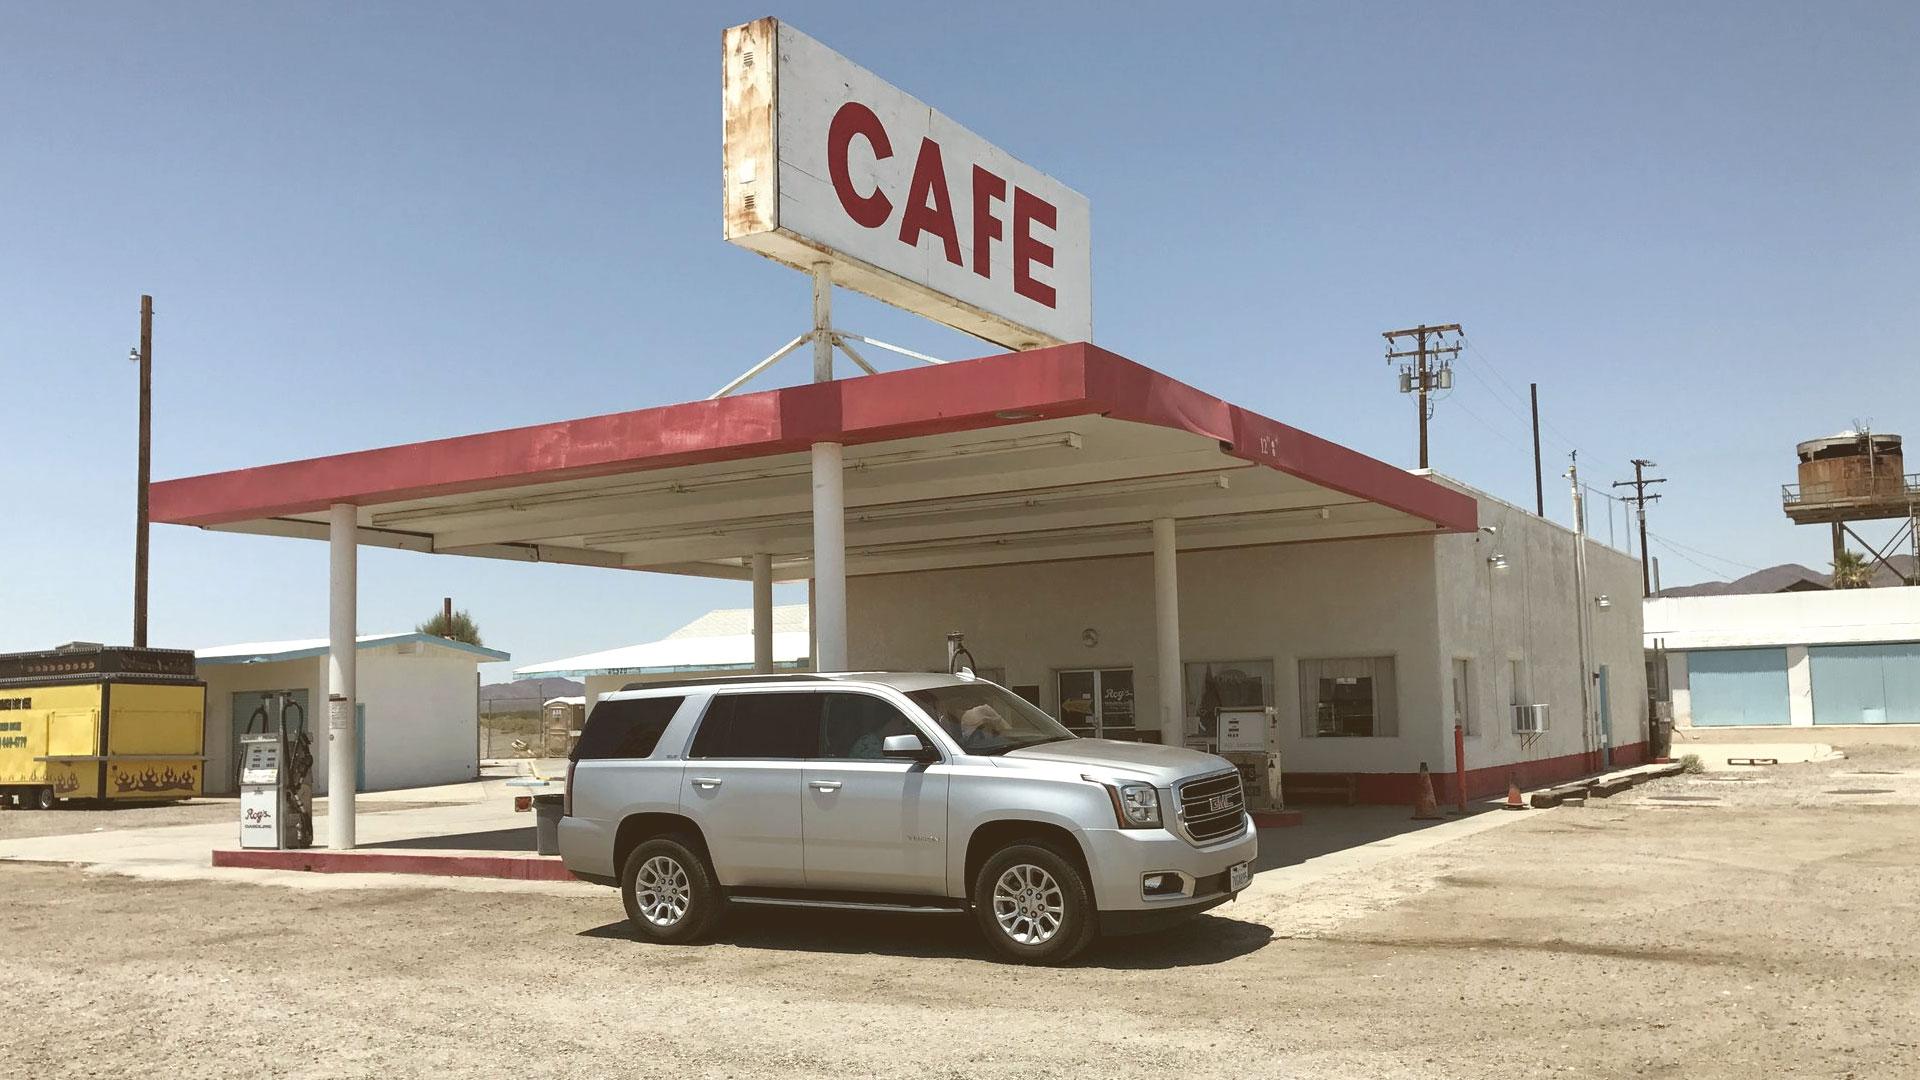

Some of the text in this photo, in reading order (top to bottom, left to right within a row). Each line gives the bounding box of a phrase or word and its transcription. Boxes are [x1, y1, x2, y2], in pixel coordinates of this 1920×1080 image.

[828, 101, 1057, 309] CAFE
[1104, 688, 1134, 701] Roy's
[1209, 793, 1234, 811] GMC
[245, 807, 271, 823] Roy's
